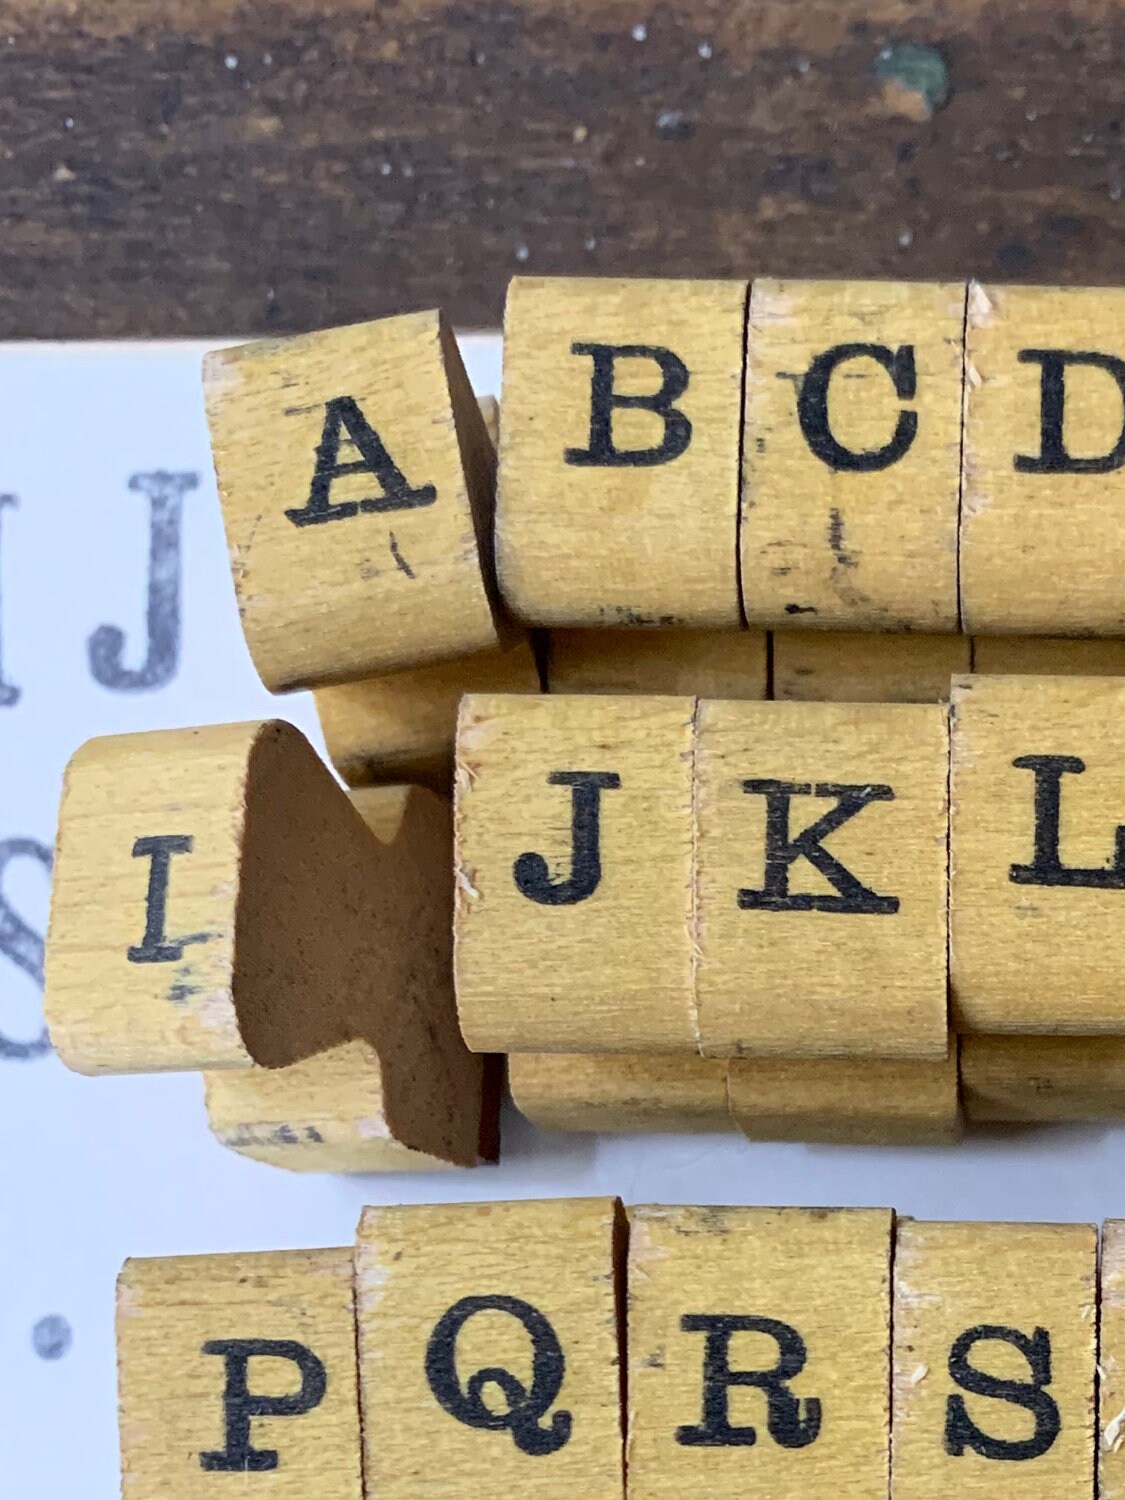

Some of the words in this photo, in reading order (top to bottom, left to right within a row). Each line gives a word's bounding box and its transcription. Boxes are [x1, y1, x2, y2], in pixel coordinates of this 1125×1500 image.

[285, 397, 436, 526] A
[566, 343, 691, 466] B
[799, 344, 917, 471] C
[88, 470, 199, 691] J
[129, 835, 192, 962] I
[514, 772, 620, 905] J
[738, 779, 900, 914] K
[201, 1339, 326, 1471] P
[424, 1294, 572, 1456] Q
[676, 1315, 822, 1448] R
[945, 1325, 1059, 1461] S
